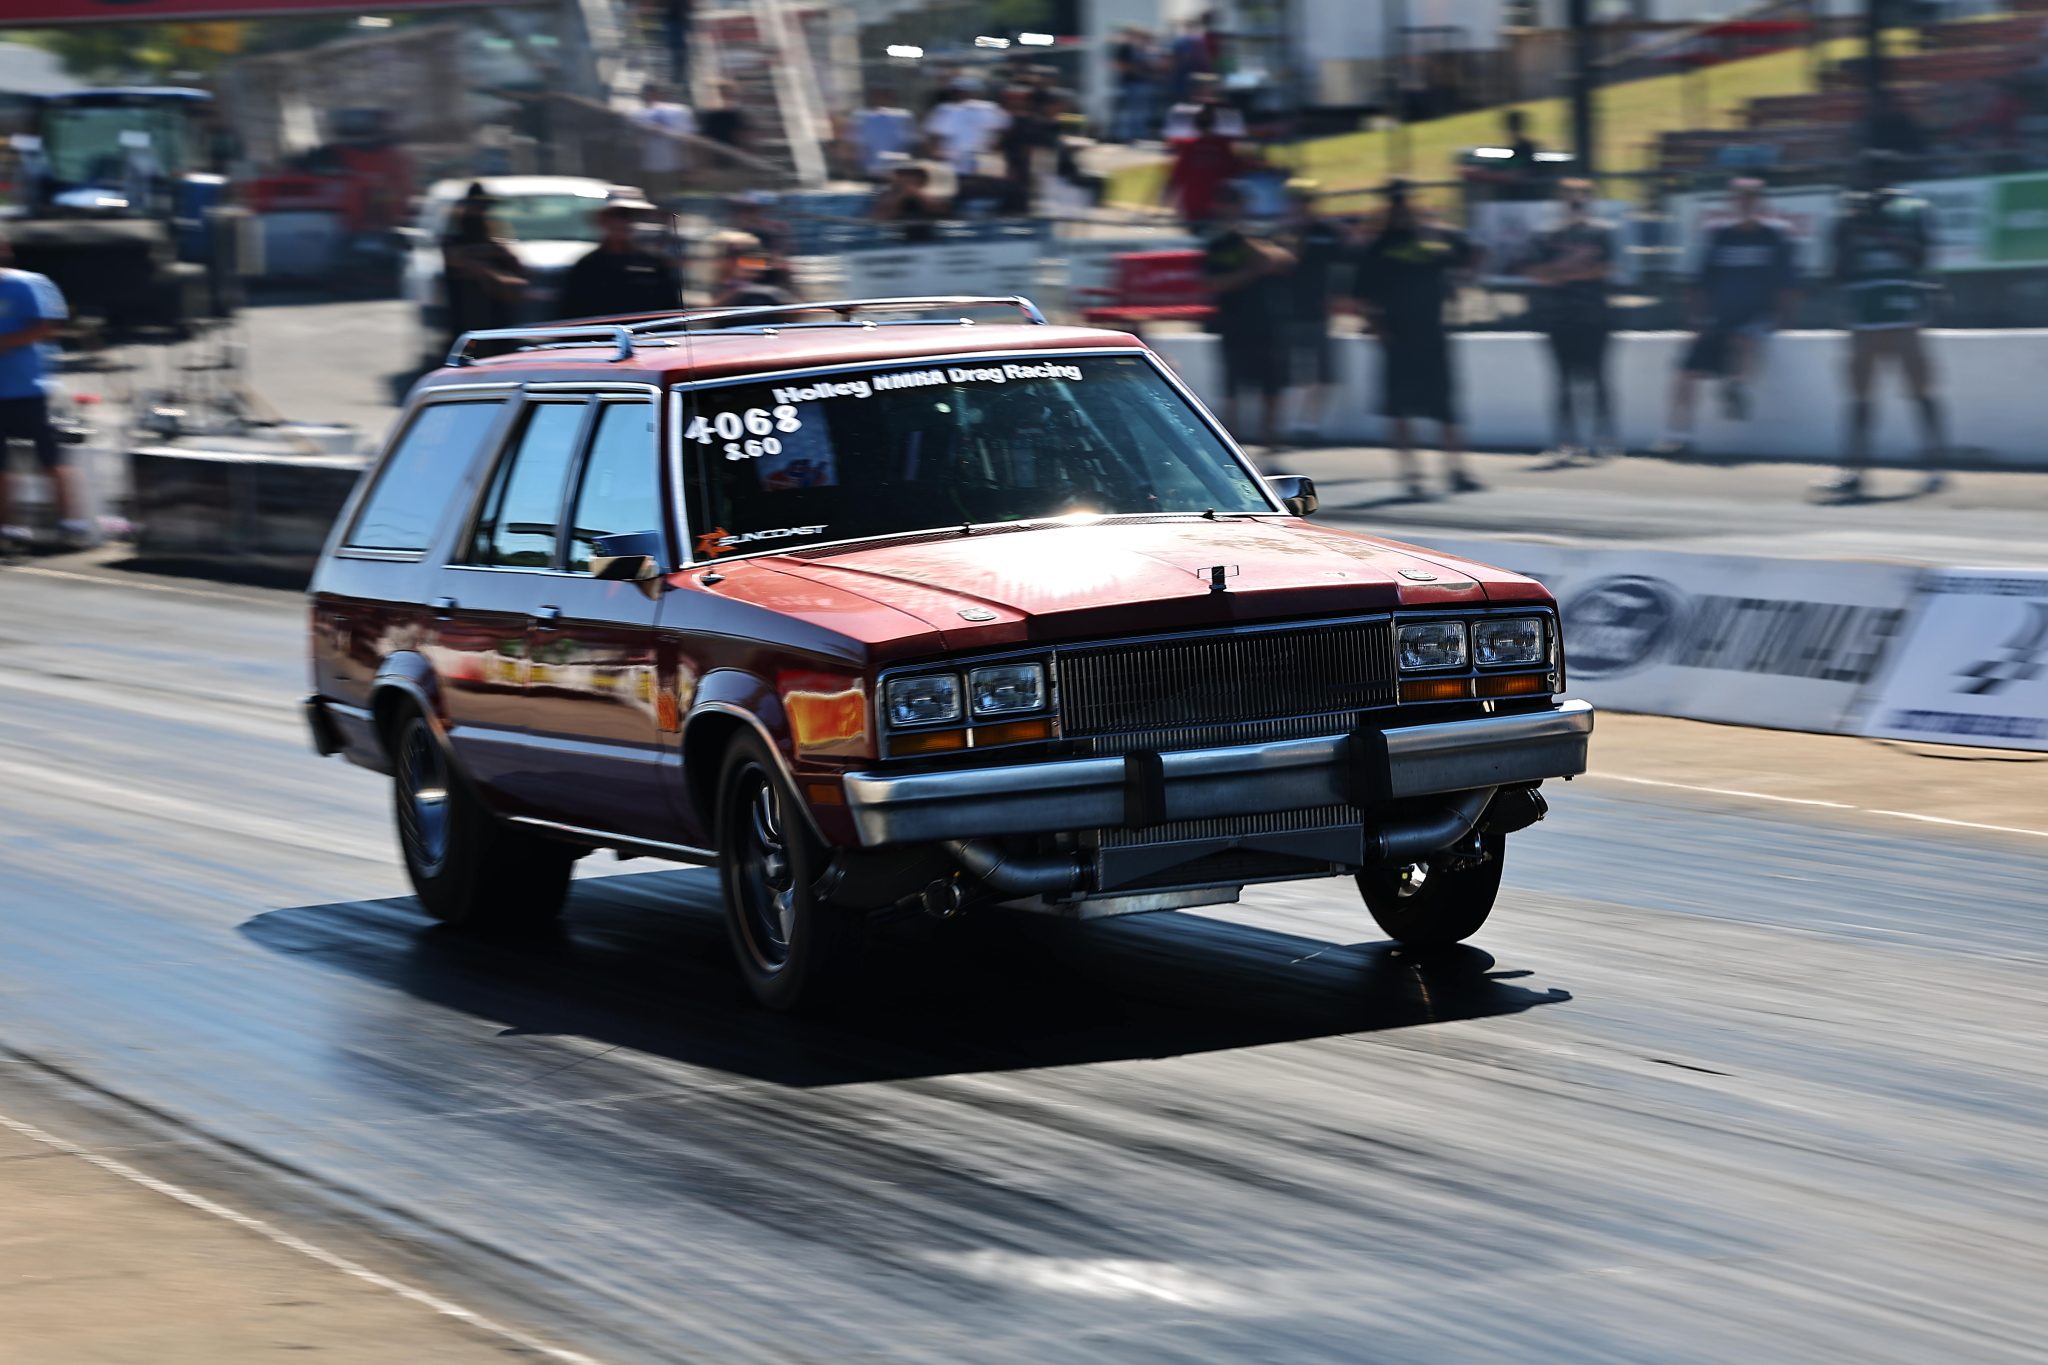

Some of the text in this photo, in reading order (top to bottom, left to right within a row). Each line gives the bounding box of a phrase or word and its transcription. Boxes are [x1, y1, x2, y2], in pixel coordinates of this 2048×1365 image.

[772, 380, 873, 404] Holley
[947, 367, 1006, 384] Drag
[1002, 361, 1083, 381] Racing
[683, 404, 803, 445] 4068
[717, 524, 829, 547] SUNCOAST
